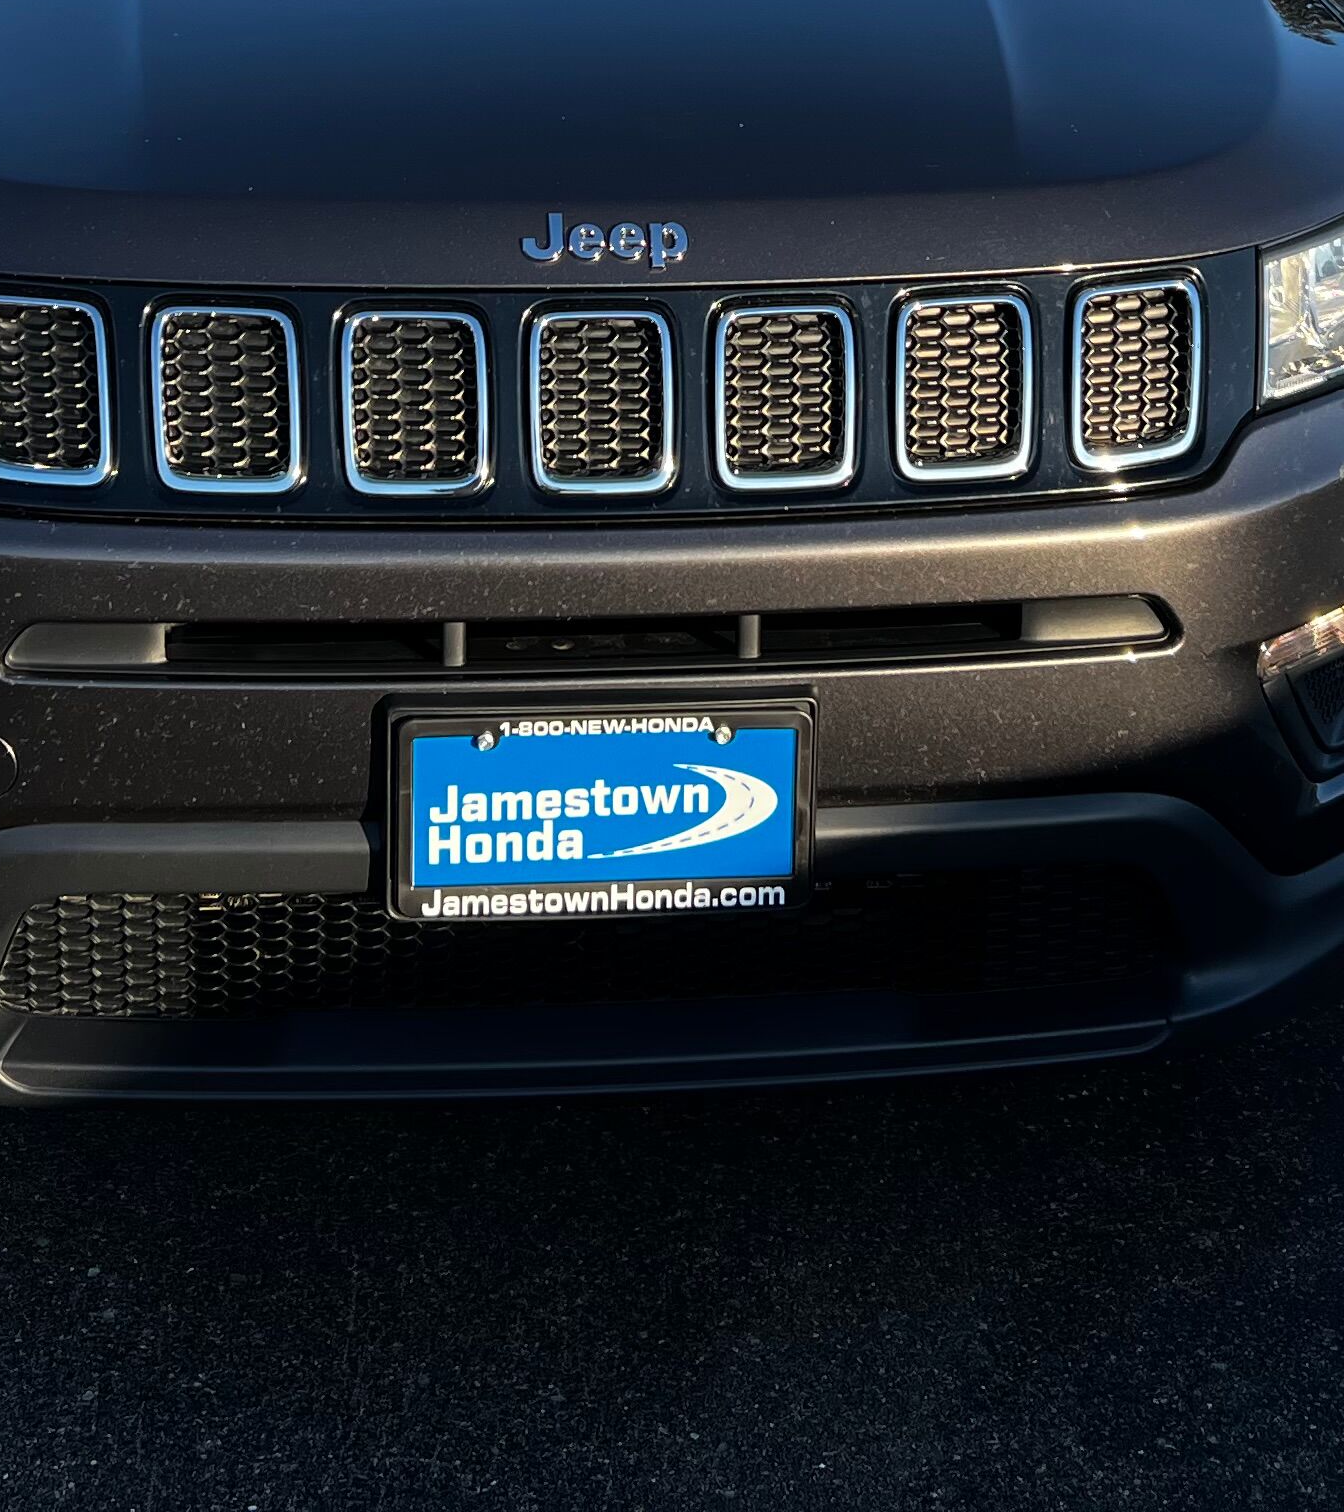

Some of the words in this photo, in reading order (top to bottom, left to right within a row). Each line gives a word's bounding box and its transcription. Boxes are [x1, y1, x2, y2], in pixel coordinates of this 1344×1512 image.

[522, 212, 688, 269] Jeep
[499, 716, 714, 737] 1-800-NEW-HONDA
[429, 779, 709, 824] Jamestown
[429, 822, 583, 865] Honda
[421, 882, 786, 917] JamestownHonda.com
